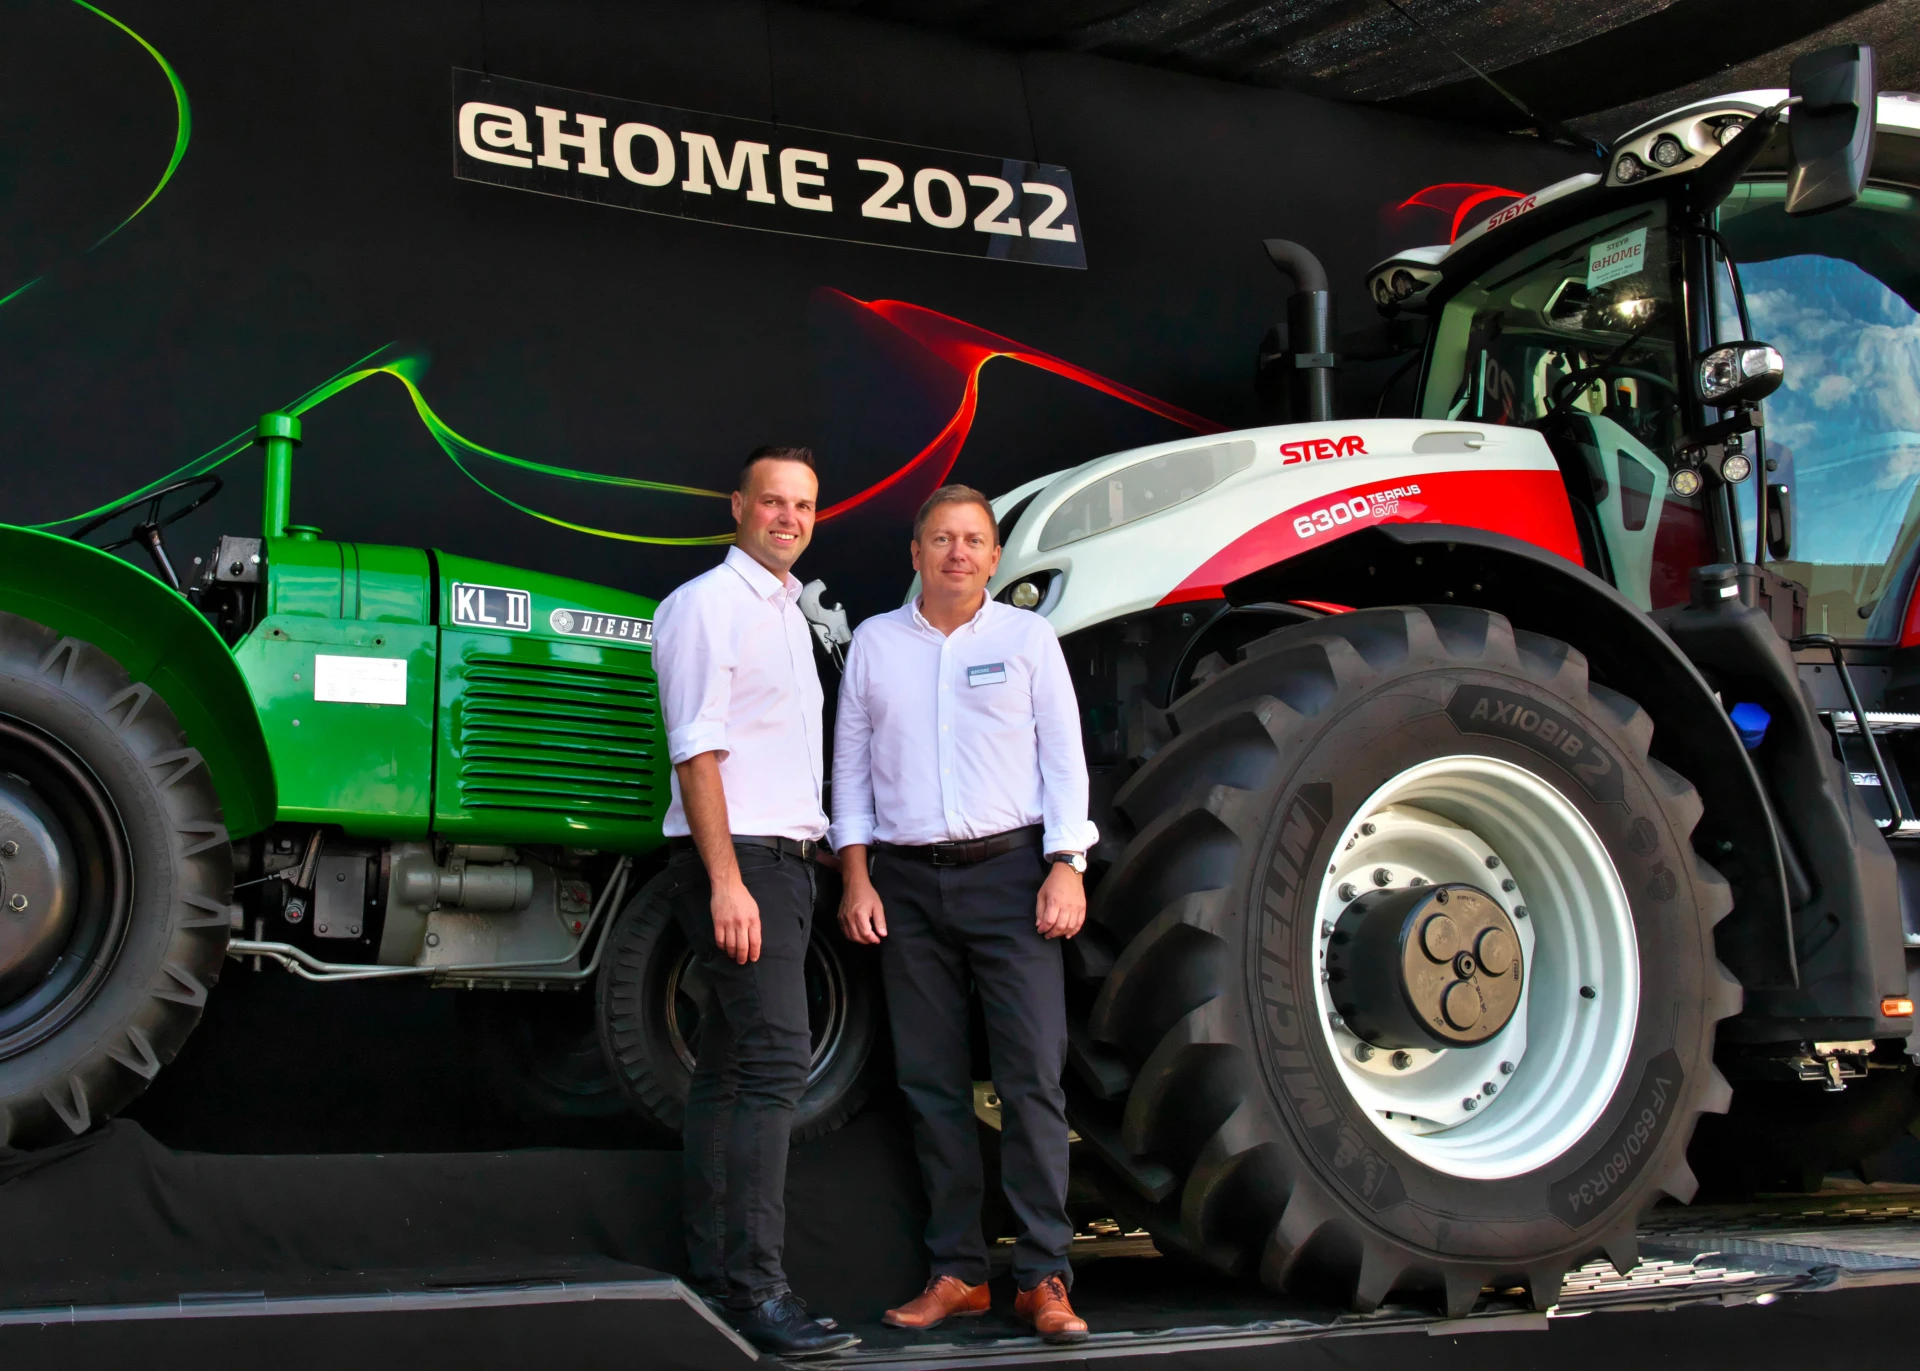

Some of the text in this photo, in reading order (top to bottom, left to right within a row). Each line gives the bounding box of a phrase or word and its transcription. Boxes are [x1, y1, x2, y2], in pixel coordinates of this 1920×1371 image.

[458, 101, 1077, 243] @HOME 2022
[1487, 196, 1537, 231] STEYR
[1591, 243, 1642, 272] @HOME
[1606, 237, 1629, 251] STEYR
[1279, 435, 1369, 465] STEYR
[1293, 484, 1421, 539] 6300 TERRUS
[1372, 501, 1399, 518] CVT
[458, 587, 527, 627] KL II
[581, 615, 653, 641] DIESEL
[1470, 697, 1612, 785] AXIOBIB 2
[1849, 774, 1881, 785] EYR
[1258, 798, 1336, 1128] MICHELIN
